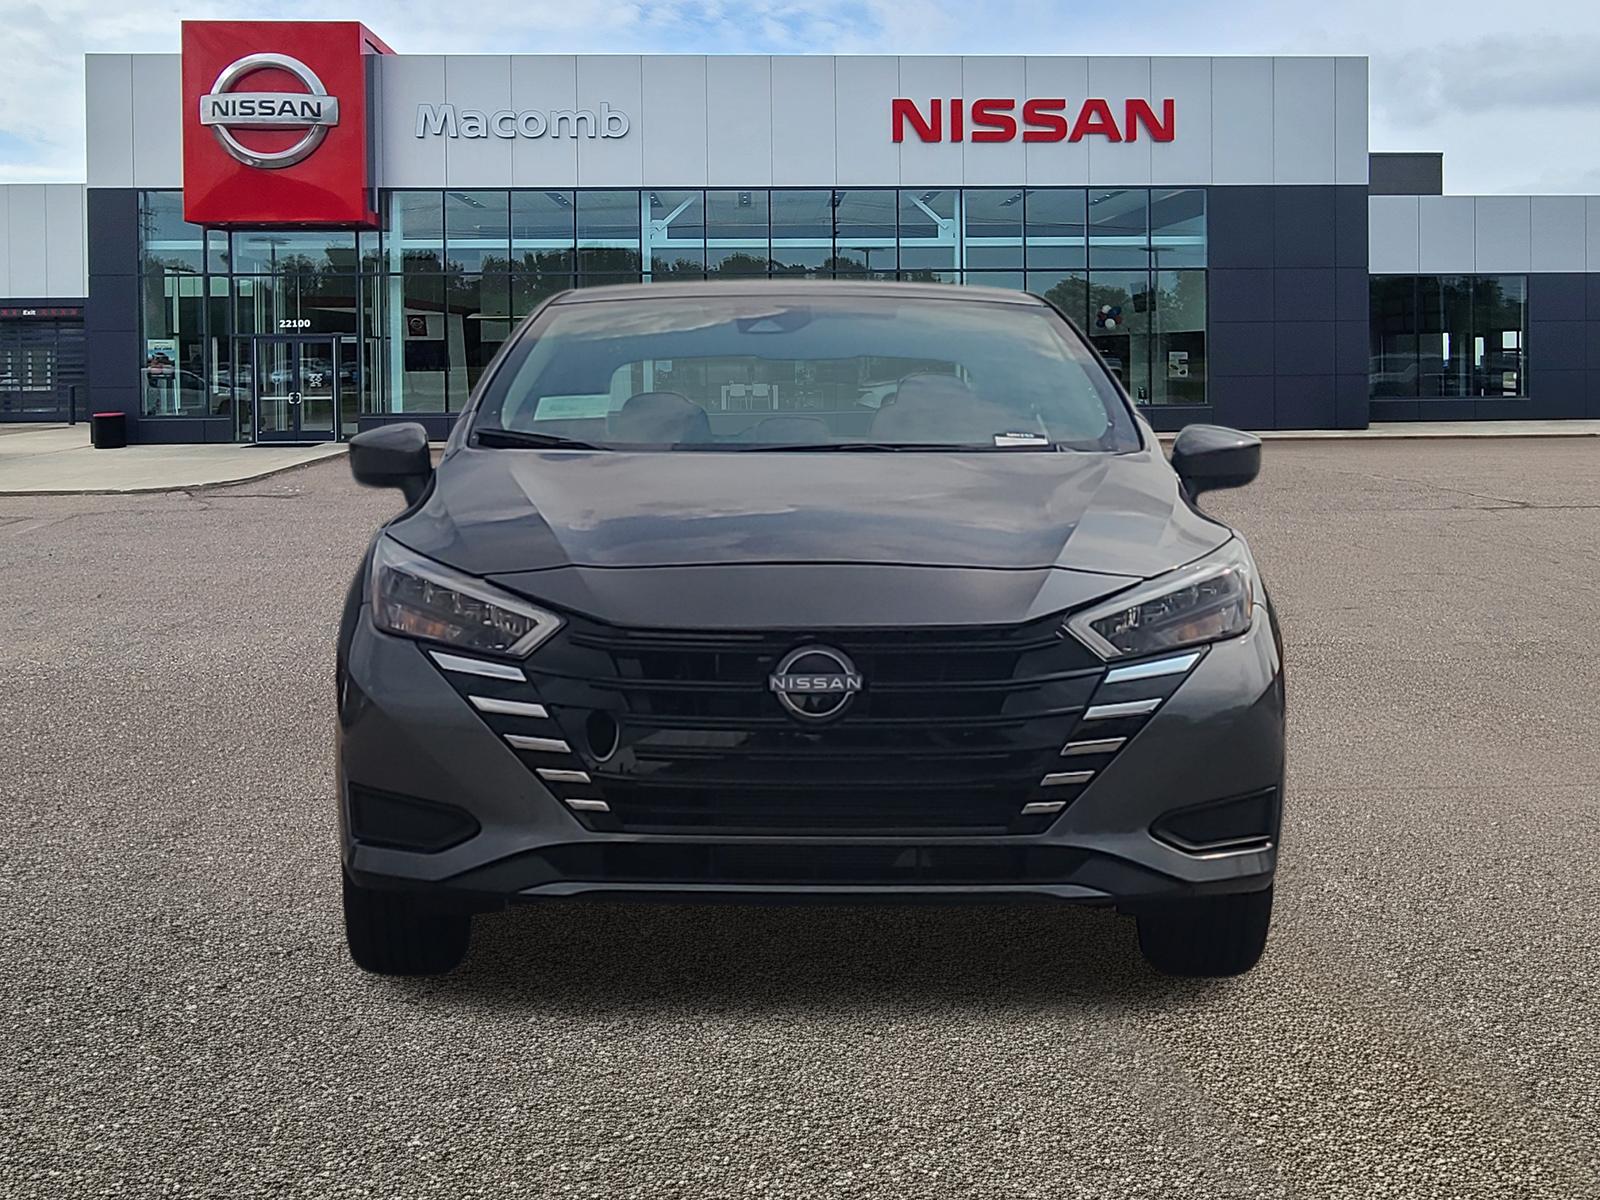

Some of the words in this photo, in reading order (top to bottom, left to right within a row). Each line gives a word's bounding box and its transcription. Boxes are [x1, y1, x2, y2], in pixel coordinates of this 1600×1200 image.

[212, 100, 322, 118] NISSAN
[415, 101, 630, 139] Macomb
[892, 98, 1176, 143] NISSAN
[279, 319, 311, 328] 22100
[770, 677, 861, 690] NISSAN
